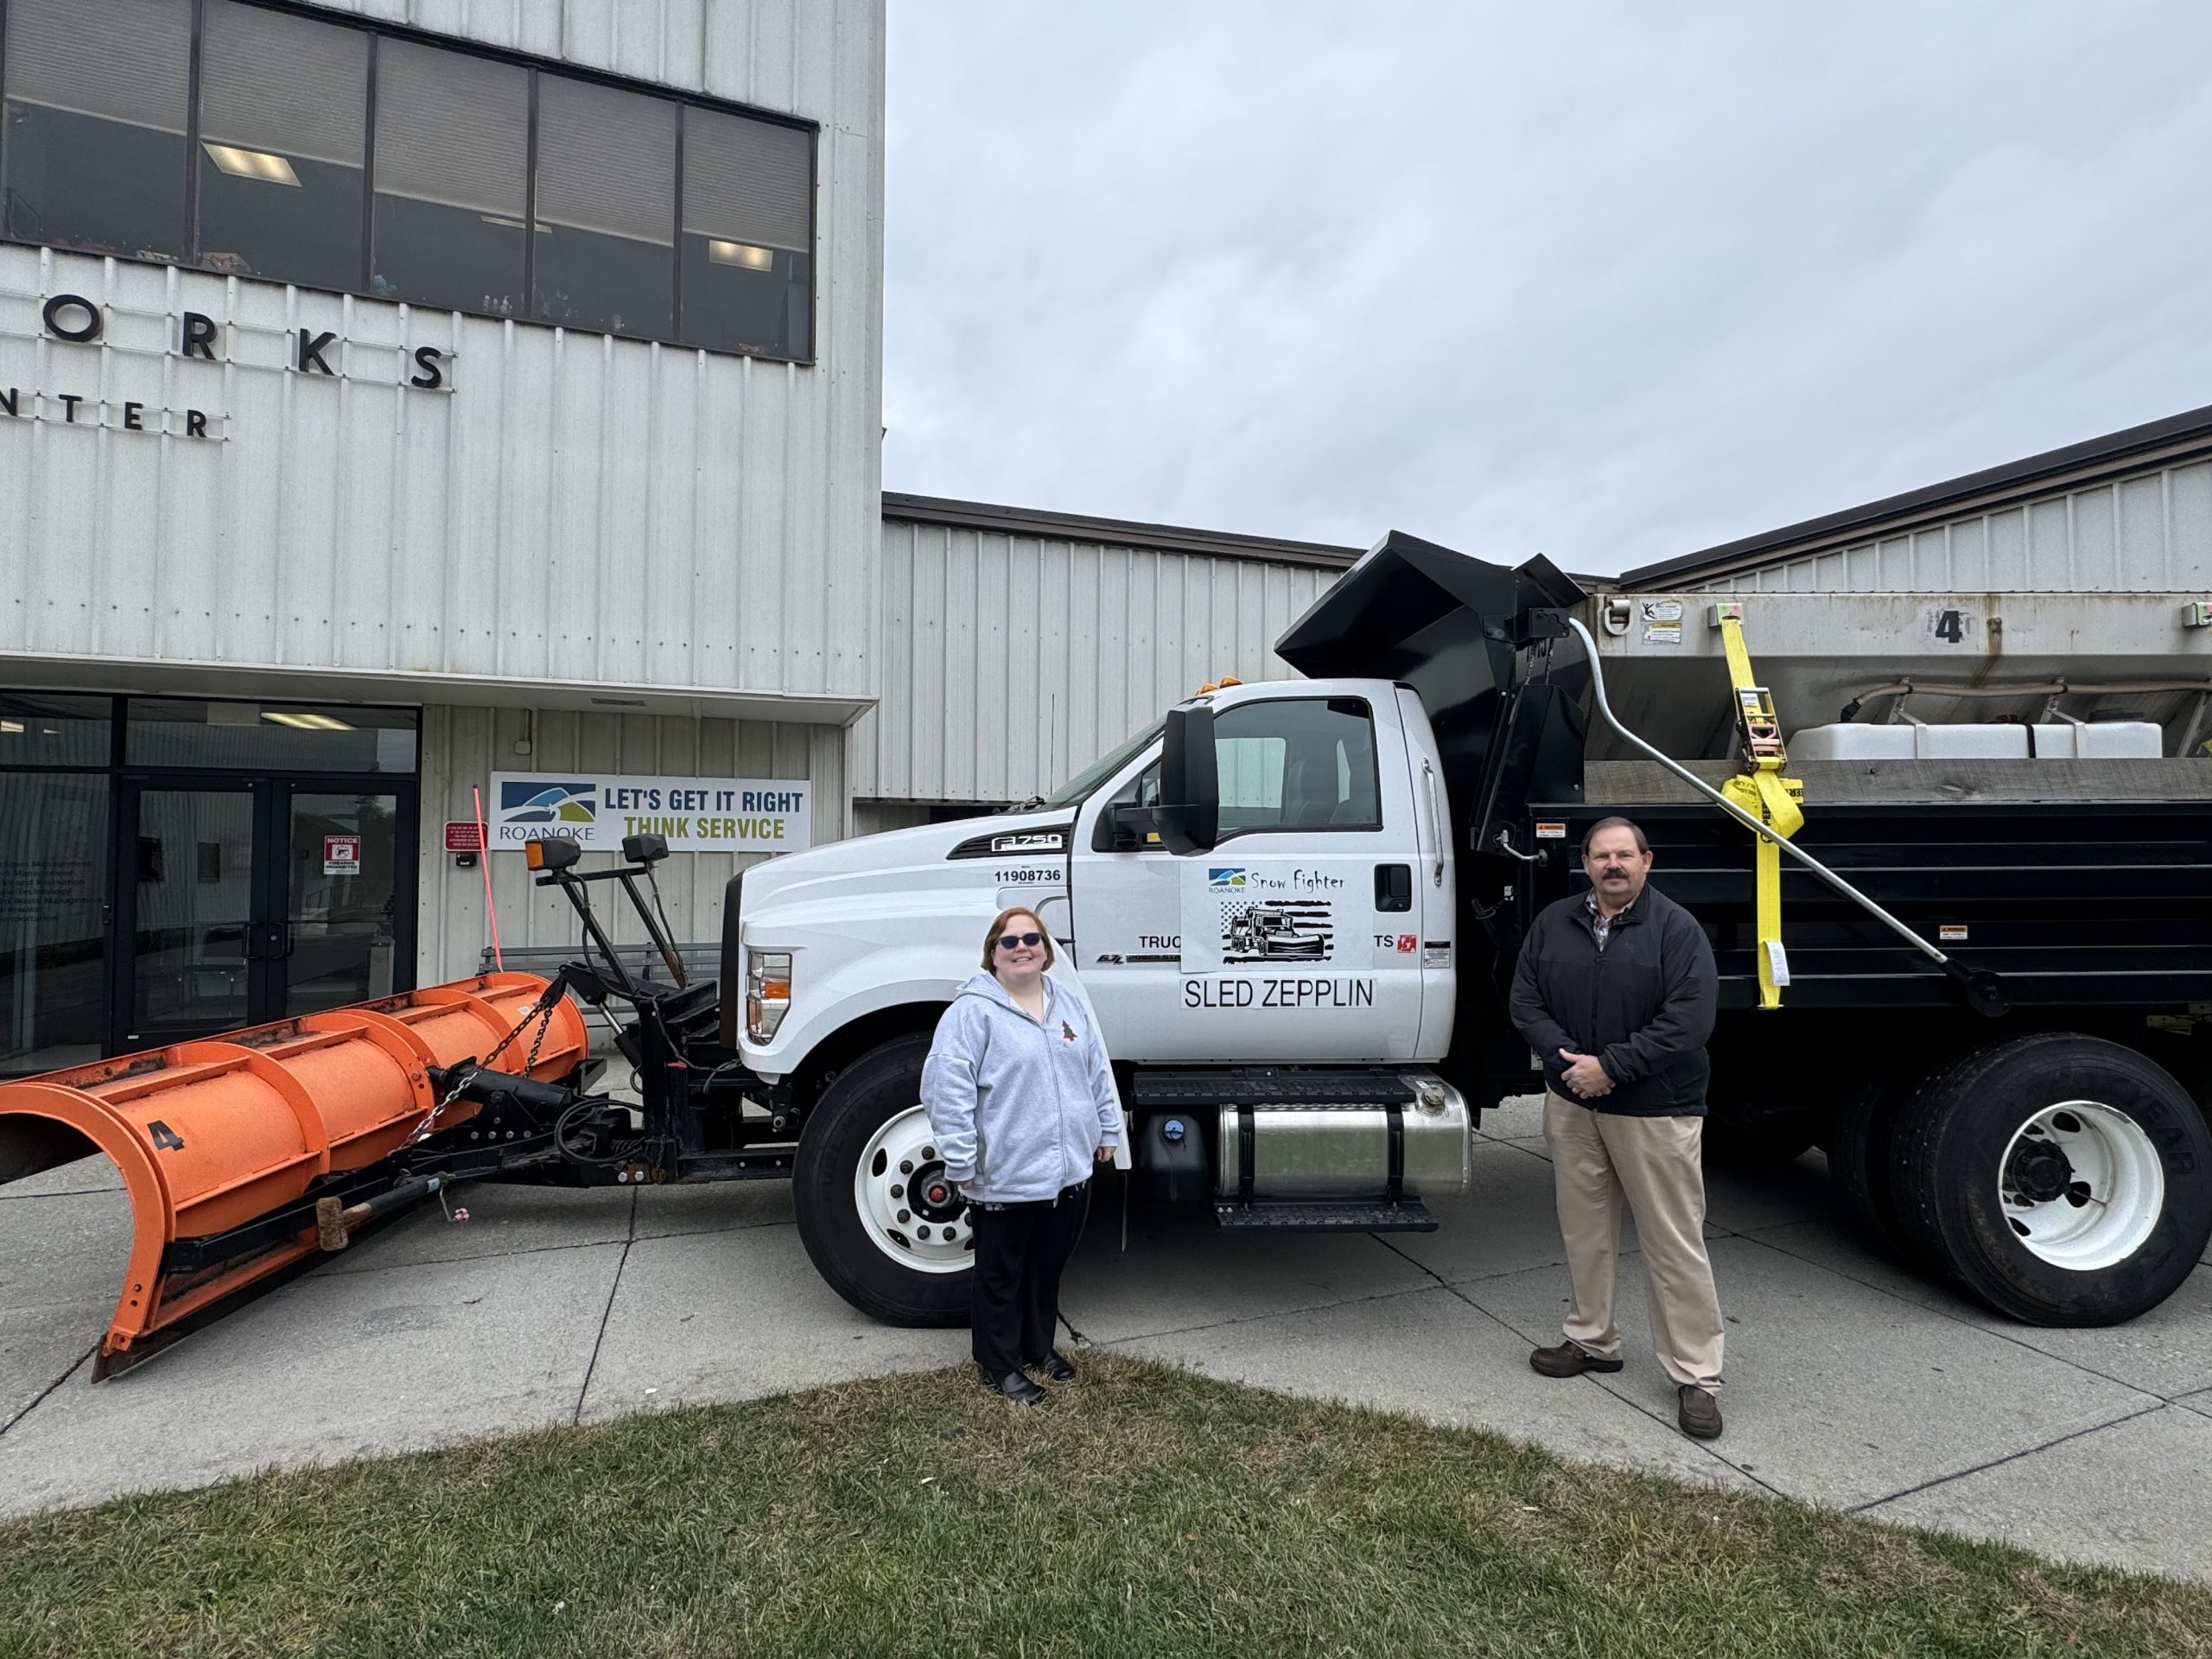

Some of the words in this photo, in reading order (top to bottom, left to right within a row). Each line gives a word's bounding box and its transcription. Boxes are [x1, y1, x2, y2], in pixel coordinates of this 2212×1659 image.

[42, 294, 442, 389] ORKS
[0, 388, 207, 438] NTER
[1936, 610, 1962, 643] 4
[605, 788, 661, 810] LET'S
[669, 790, 709, 810] GET
[716, 791, 734, 811] IT
[742, 791, 804, 812] RIGHT
[500, 826, 595, 841] ROANOKE
[624, 817, 690, 838] THINK
[696, 817, 785, 839] SERVICE
[995, 870, 1061, 882] 11908736
[1251, 873, 1286, 889] Snow
[1294, 869, 1345, 893] Fighter
[1374, 935, 1394, 948] TS
[1185, 980, 1253, 1007] SLED
[1262, 979, 1372, 1007] ZEPPLIN
[147, 1120, 184, 1151] 4
